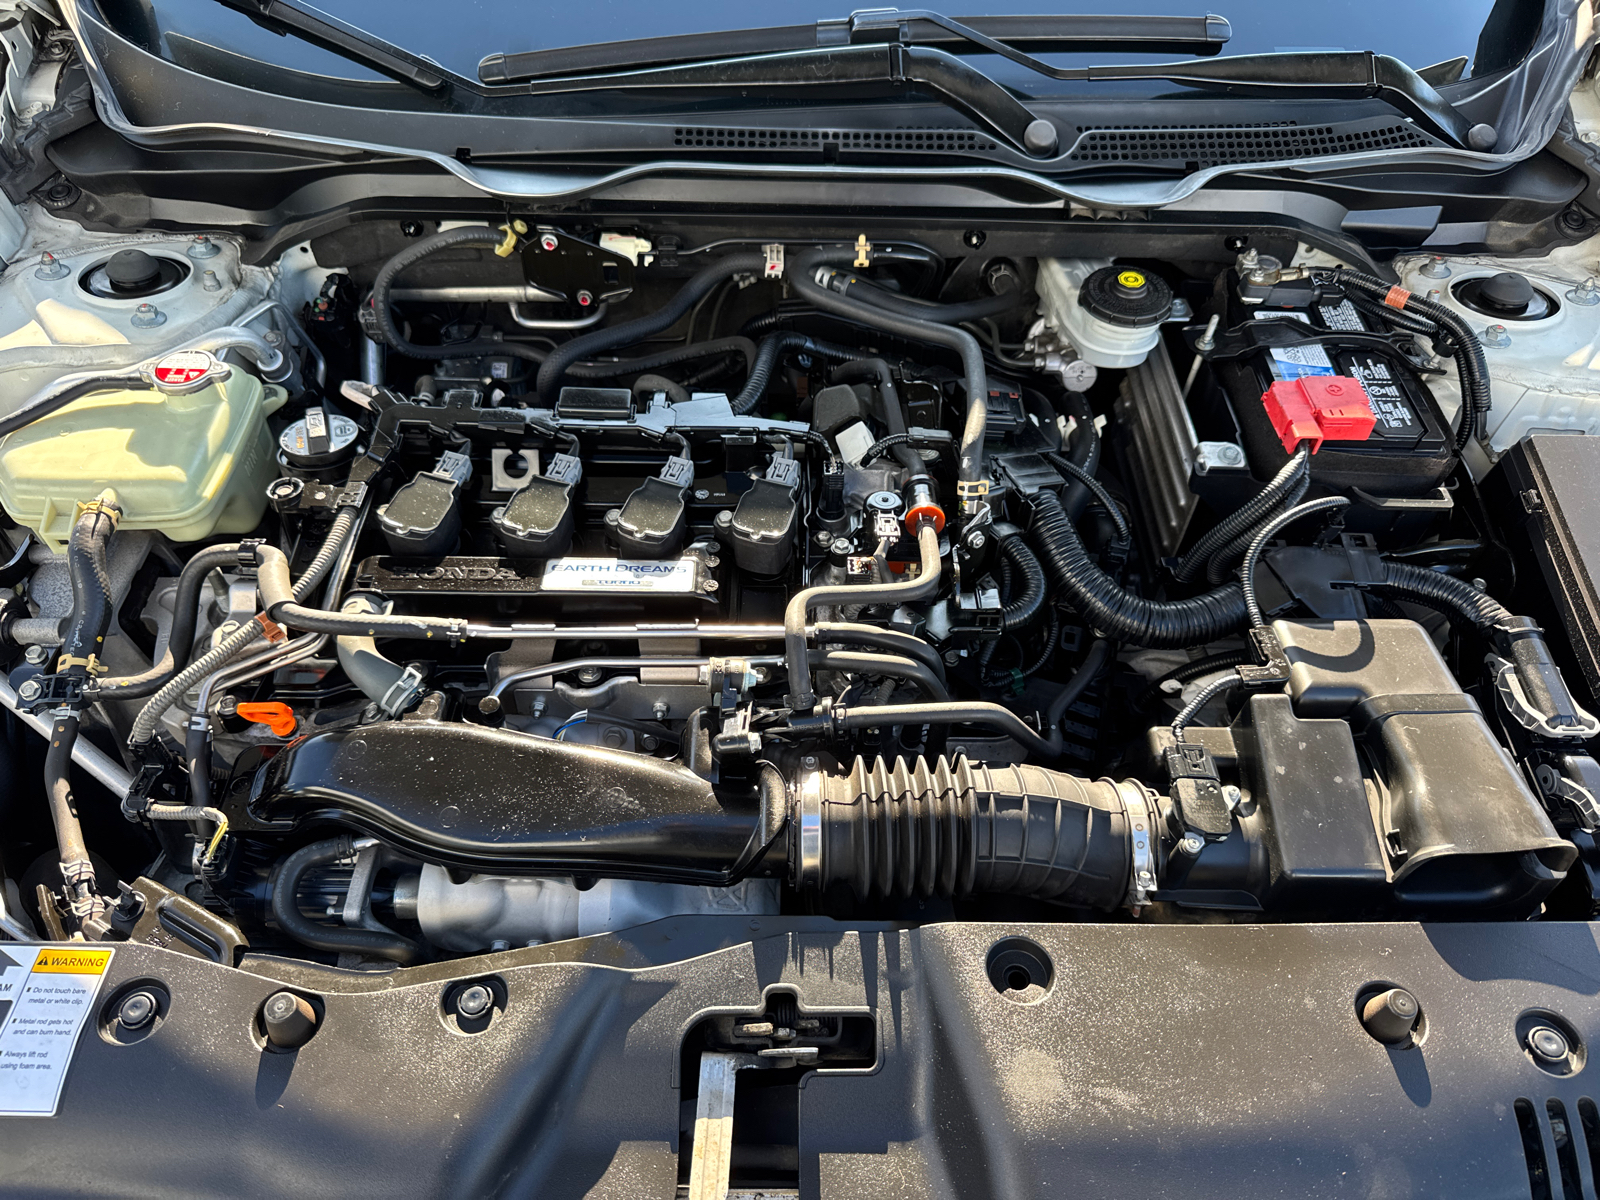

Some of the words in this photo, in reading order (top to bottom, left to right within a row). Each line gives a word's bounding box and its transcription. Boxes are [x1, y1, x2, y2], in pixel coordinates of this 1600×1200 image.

[551, 564, 611, 572] EARTH
[614, 564, 687, 573] DREAMS
[391, 566, 521, 581] HONDA
[51, 958, 104, 967] WARNING
[47, 1018, 61, 1026] gets
[4, 1050, 27, 1059] Always
